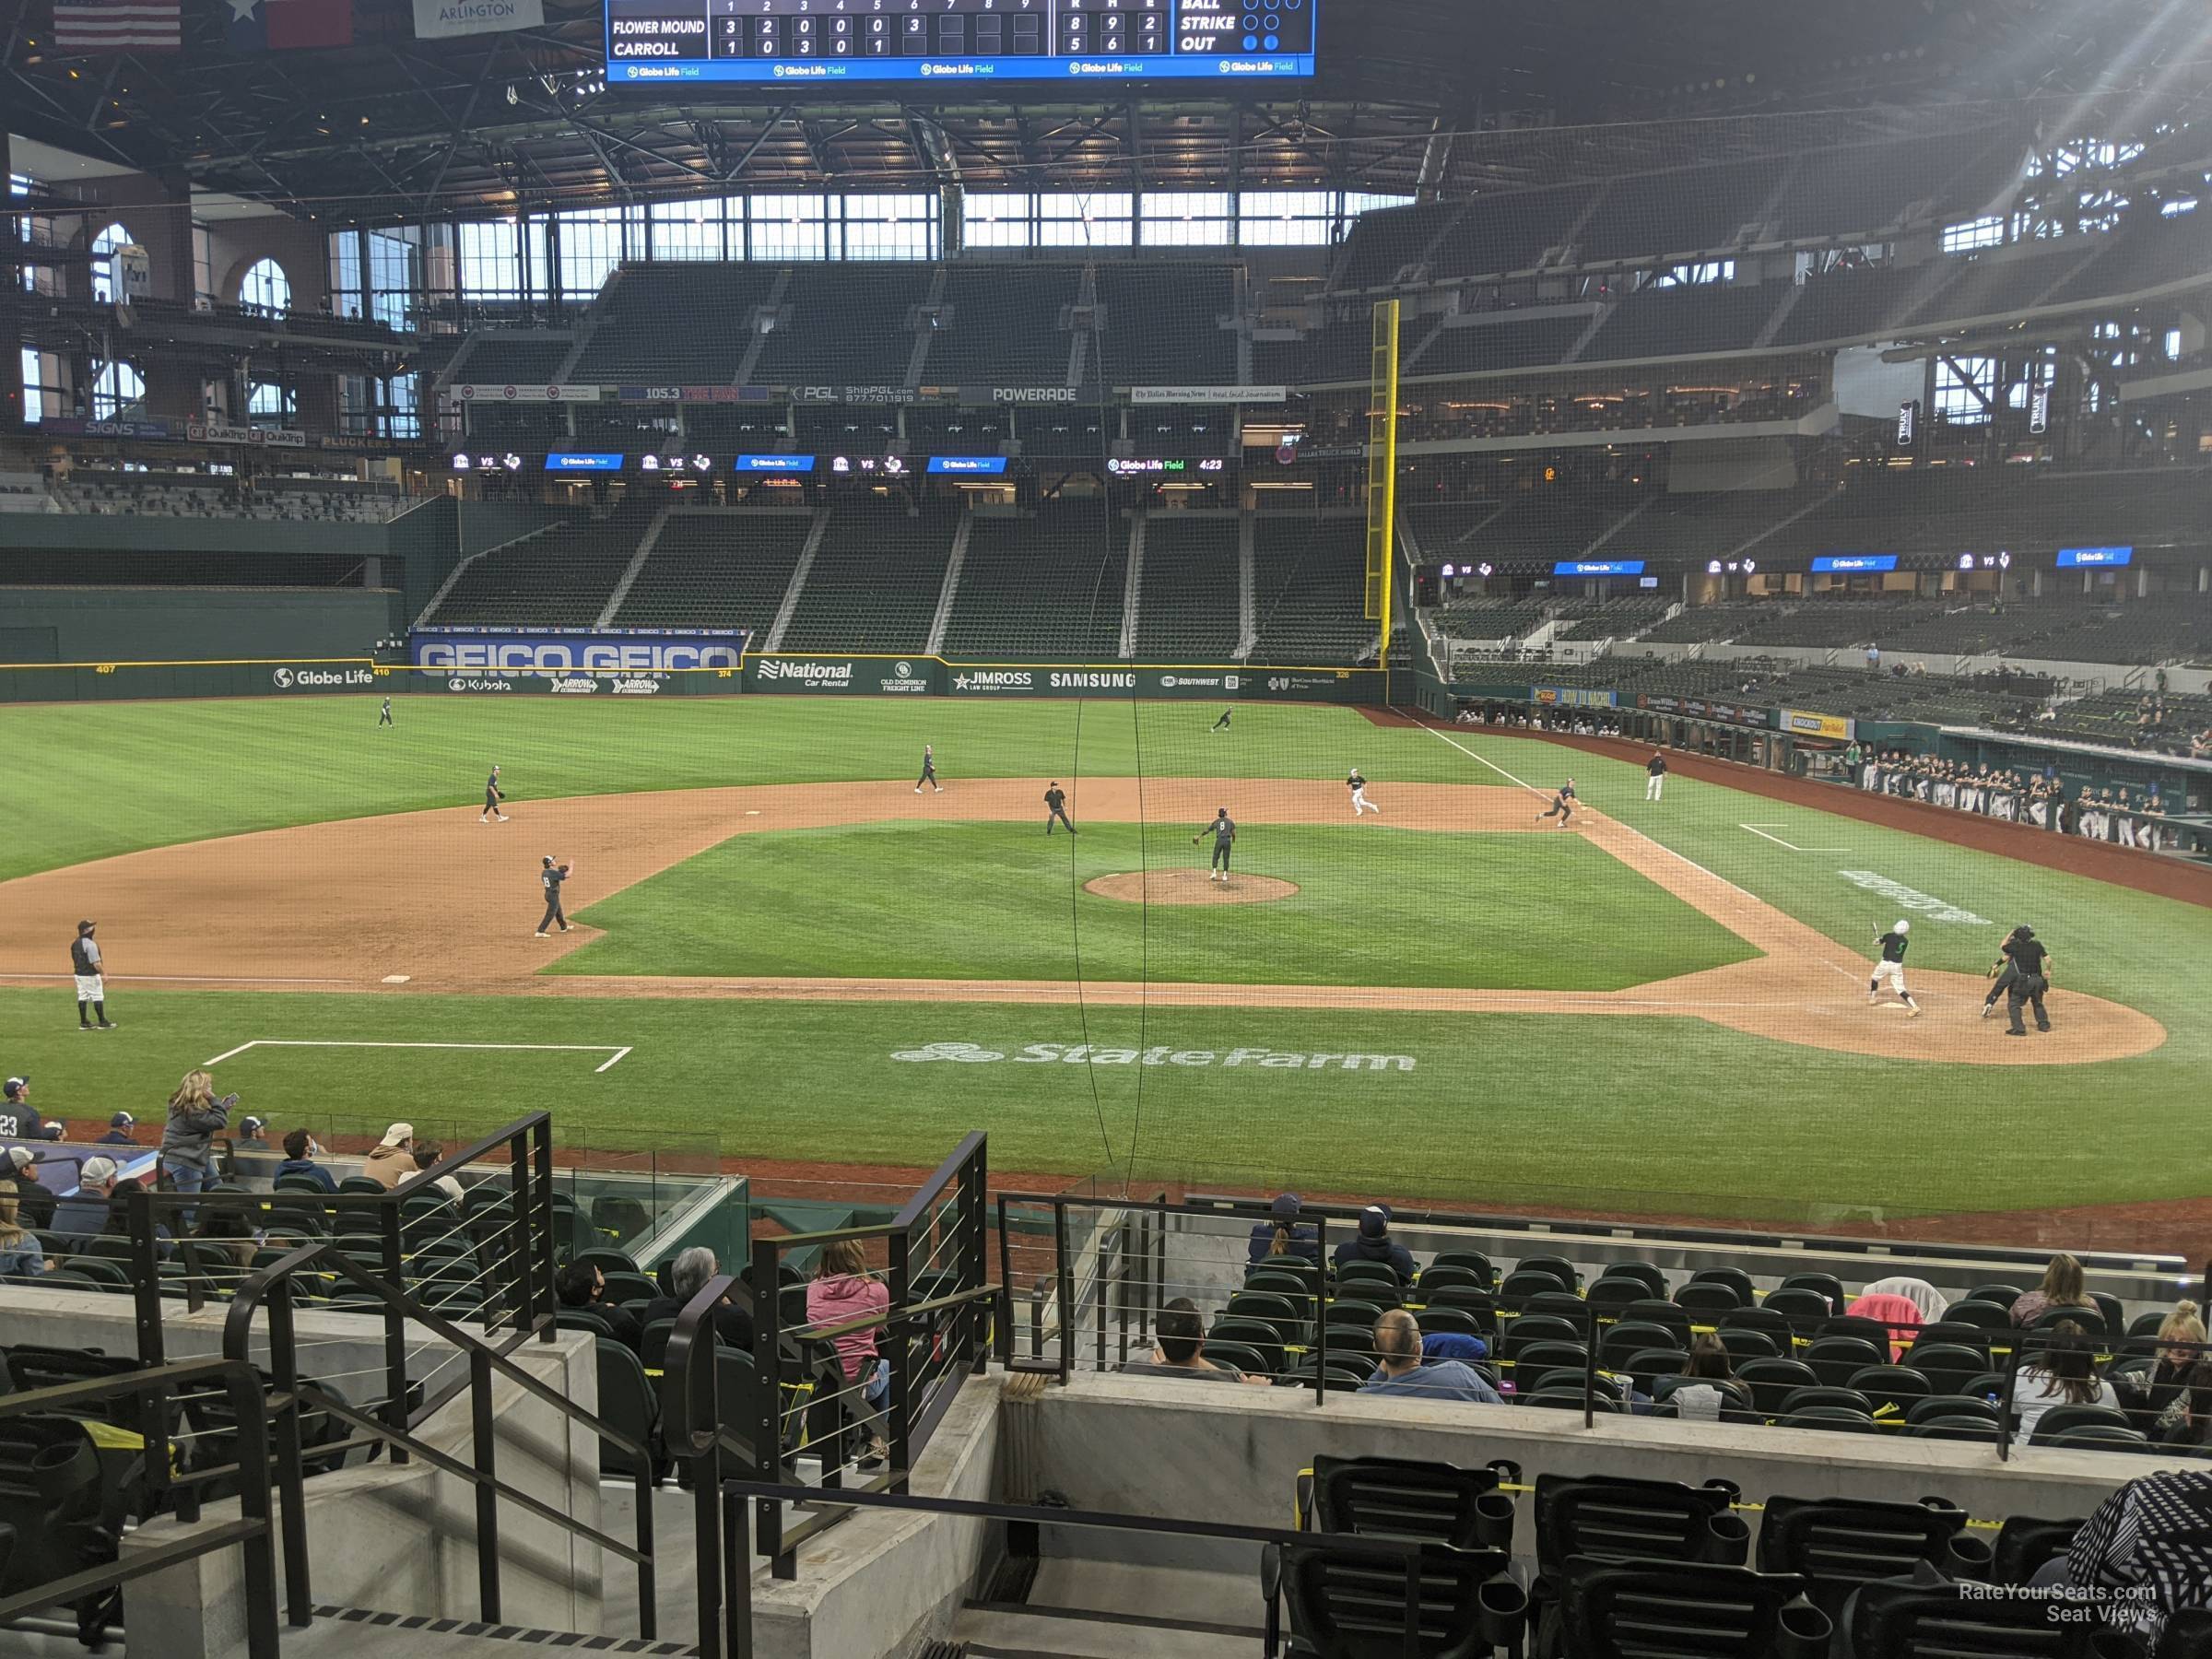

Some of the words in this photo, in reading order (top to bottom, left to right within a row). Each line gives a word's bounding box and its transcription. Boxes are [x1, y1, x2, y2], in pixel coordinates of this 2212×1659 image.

[728, 2, 734, 11] 1
[763, 1, 771, 11] 2
[800, 1, 808, 11] 3
[837, 0, 844, 10] 4
[874, 0, 882, 10] 5
[911, 0, 918, 9] 6
[1182, 0, 1221, 9] BALL
[440, 4, 515, 21] ARLINGTON
[613, 21, 658, 34] FLOWER
[661, 21, 705, 33] MOUND
[726, 21, 735, 33] 3
[763, 20, 771, 32] 2
[800, 20, 809, 32] 0
[837, 20, 845, 31] 0
[874, 19, 882, 31] 0
[911, 19, 919, 31] 3
[1071, 18, 1079, 29] 8
[1109, 17, 1117, 29] 9
[1146, 17, 1155, 29] 2
[1182, 17, 1235, 29] STRIKE
[614, 43, 679, 56] CARROLL
[728, 41, 735, 53] 1
[763, 41, 772, 53] 0
[801, 41, 809, 53] 3
[837, 41, 846, 53] 0
[875, 40, 882, 52] 1
[1071, 38, 1079, 50] 5
[1108, 38, 1117, 50] 6
[1147, 37, 1154, 49] 1
[1182, 37, 1216, 50] OUT
[639, 68, 663, 76] Globe
[665, 68, 679, 76] Life
[681, 68, 700, 76] Field
[785, 67, 808, 76] Globe
[810, 66, 826, 76] Life
[828, 66, 846, 75] Field
[933, 65, 957, 74] Globe
[959, 65, 973, 74] Life
[975, 65, 994, 73] Field
[1081, 64, 1105, 73] Globe
[1107, 64, 1123, 73] Life
[1124, 63, 1143, 72] Field
[1231, 62, 1254, 71] Globe
[1257, 62, 1273, 71] Life
[1275, 62, 1293, 71] Field
[646, 388, 679, 399] 105.3
[804, 387, 838, 398] PGL
[993, 388, 1077, 401] POWERADE
[2031, 394, 2041, 424] TRULY
[1899, 408, 1907, 438] TRULY
[208, 428, 246, 441] QuikTrip
[266, 430, 303, 444] QuikTrip
[324, 436, 392, 449] PLUCKERS
[481, 457, 494, 465] VS
[670, 457, 683, 467] VS
[861, 460, 874, 468] VS
[1120, 460, 1146, 470] Globe
[1147, 460, 1162, 470] Life
[1164, 461, 1184, 470] Field
[1199, 460, 1222, 470] 4:23
[419, 643, 572, 677] GEICO
[583, 645, 737, 678] GEICO
[96, 665, 115, 674] 407
[779, 661, 853, 678] National
[297, 670, 342, 685] Globe
[346, 669, 373, 684] Life
[1050, 673, 1136, 688] SAMSUNG
[1178, 677, 1220, 686] SOUTHWEST
[468, 679, 512, 690] Kubota
[562, 678, 591, 688] ARROW
[623, 678, 652, 688] ARROW
[1219, 821, 1225, 831] 8
[1895, 942, 1907, 955] 5
[1015, 1042, 1216, 1066] State
[1221, 1047, 1417, 1071] Farm
[0, 1114, 18, 1137] 23
